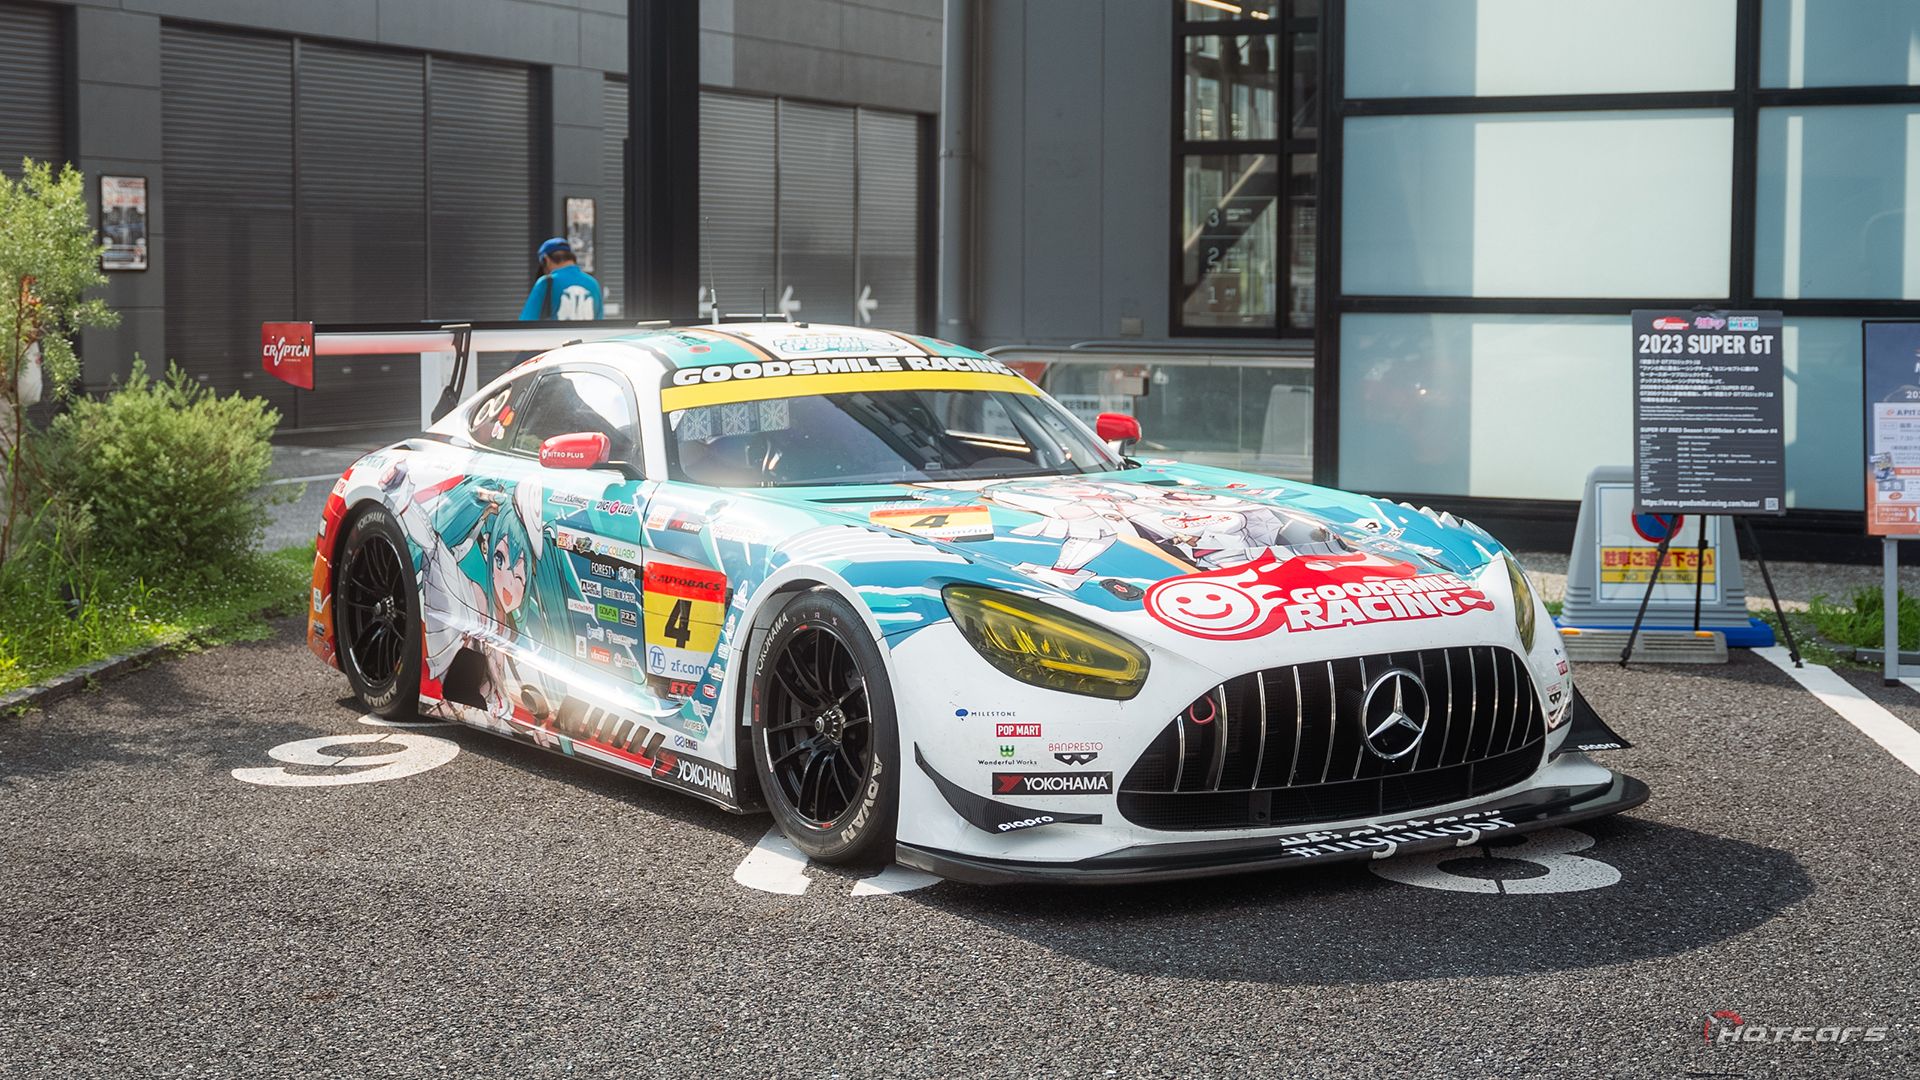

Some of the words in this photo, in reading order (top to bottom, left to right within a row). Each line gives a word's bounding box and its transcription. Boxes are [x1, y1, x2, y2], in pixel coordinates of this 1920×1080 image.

[1639, 334, 1683, 354] 2023
[1687, 335, 1746, 354] SUPER
[1749, 335, 1774, 355] GT
[673, 356, 898, 386] GOODSMILE
[906, 355, 1017, 376] RACING
[910, 514, 949, 528] 4
[592, 562, 612, 576] FOREST
[657, 575, 721, 591] AUTOBACS
[1290, 574, 1467, 604] GOODSMILE
[1286, 592, 1460, 632] RACING
[664, 598, 692, 649] 4
[755, 612, 789, 678] YOKOHAMA
[650, 651, 664, 668] ZF
[671, 660, 704, 675] zf.com
[998, 725, 1014, 735] POP
[1016, 725, 1040, 735] MART
[1049, 742, 1104, 752] BANPRESTO
[677, 758, 734, 798] YOKOHAMA
[1023, 777, 1109, 791] YOKOHAMA
[841, 753, 884, 844] ADVAN
